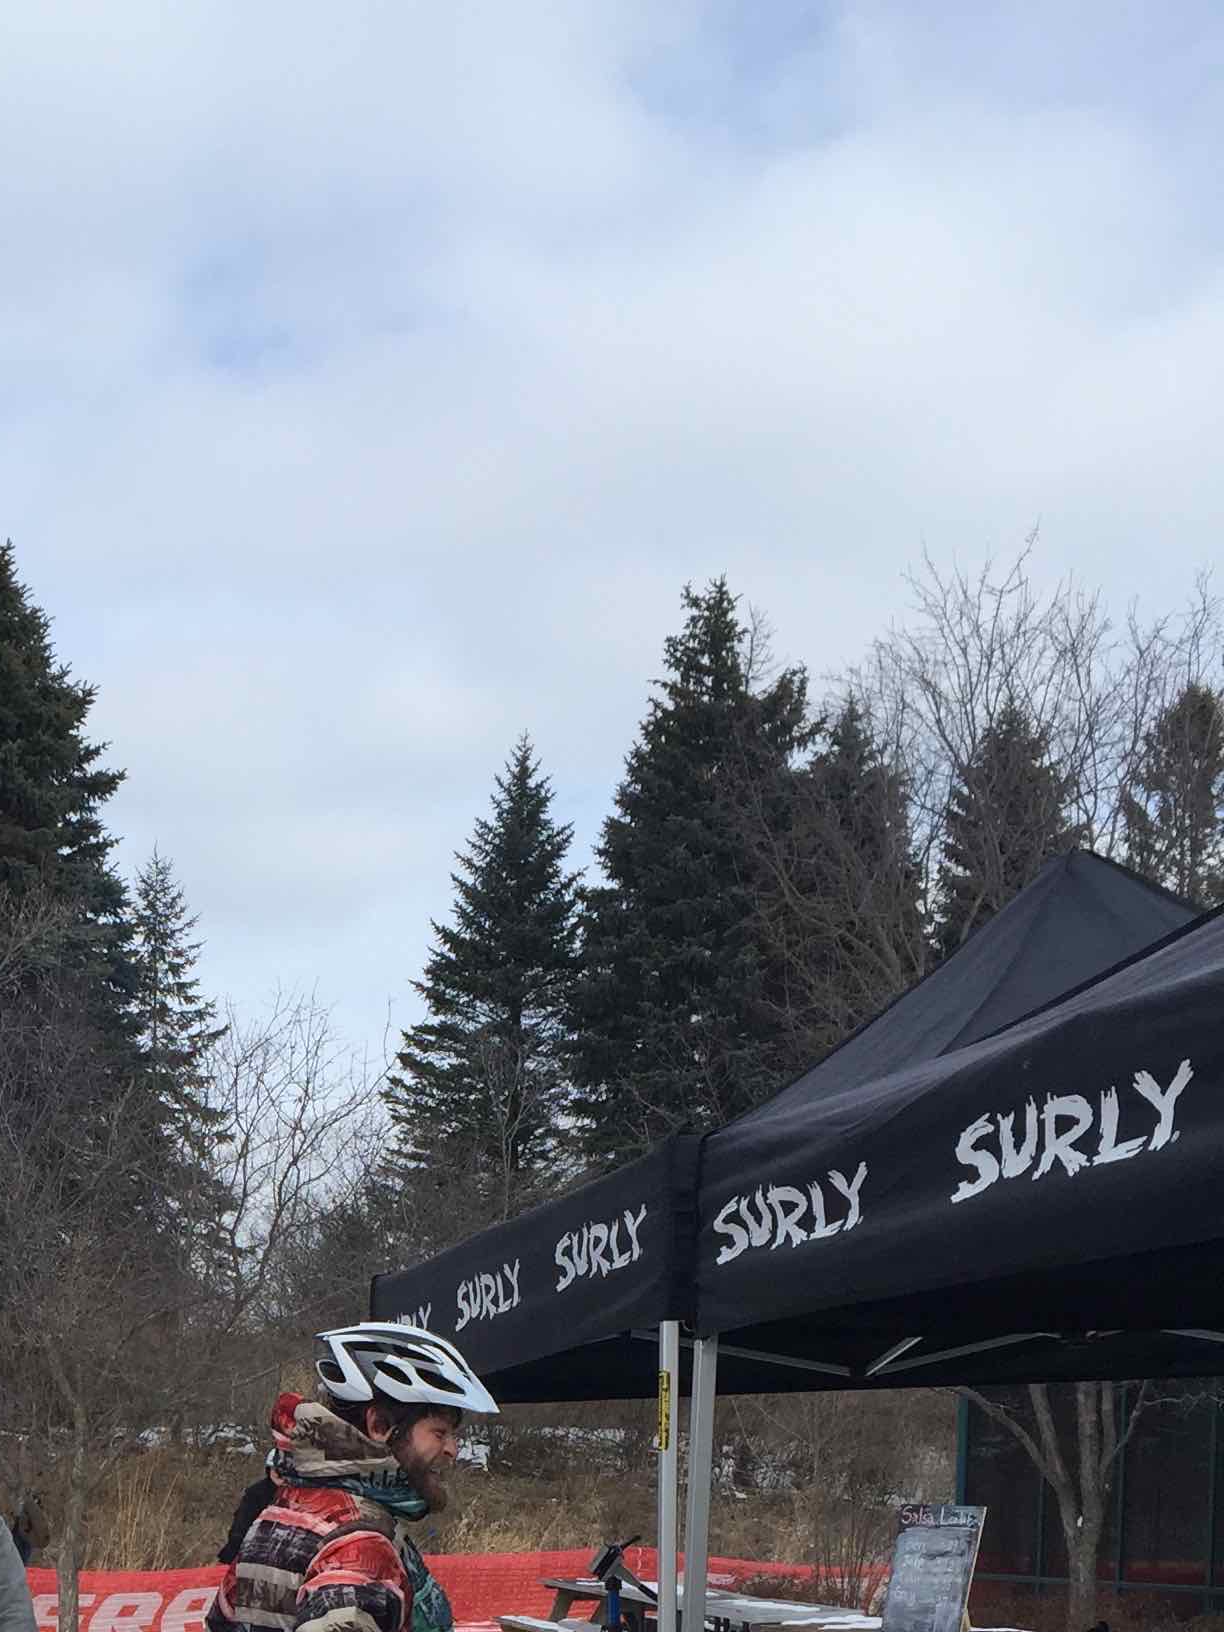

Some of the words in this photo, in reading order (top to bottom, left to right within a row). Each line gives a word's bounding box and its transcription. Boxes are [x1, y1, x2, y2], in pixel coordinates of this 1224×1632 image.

[951, 1058, 1194, 1203] SURLY
[555, 1203, 647, 1293] SURLY
[713, 1161, 868, 1265] SURLY
[456, 1258, 520, 1332] SURLY
